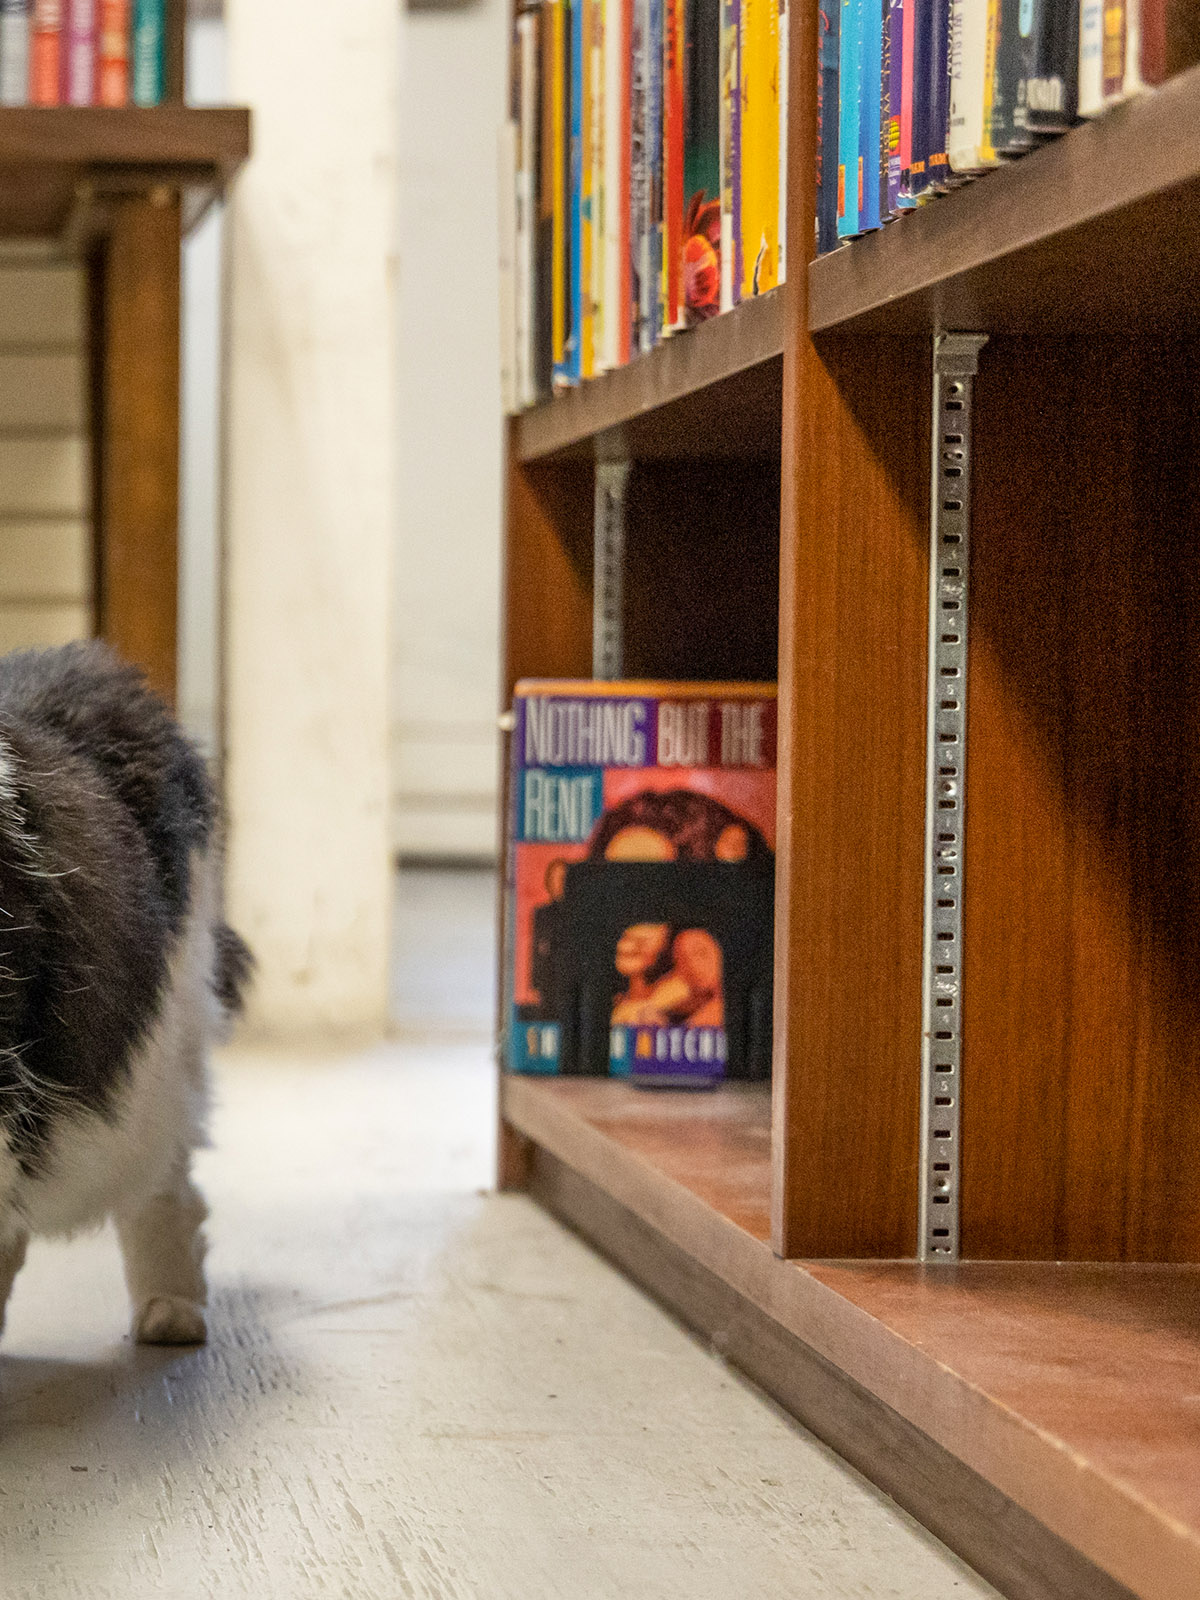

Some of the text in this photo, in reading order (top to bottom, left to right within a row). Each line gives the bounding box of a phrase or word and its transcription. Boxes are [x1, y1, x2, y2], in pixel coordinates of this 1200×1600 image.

[525, 697, 763, 767] NOTHING BUT THE
[524, 769, 594, 839] RENT
